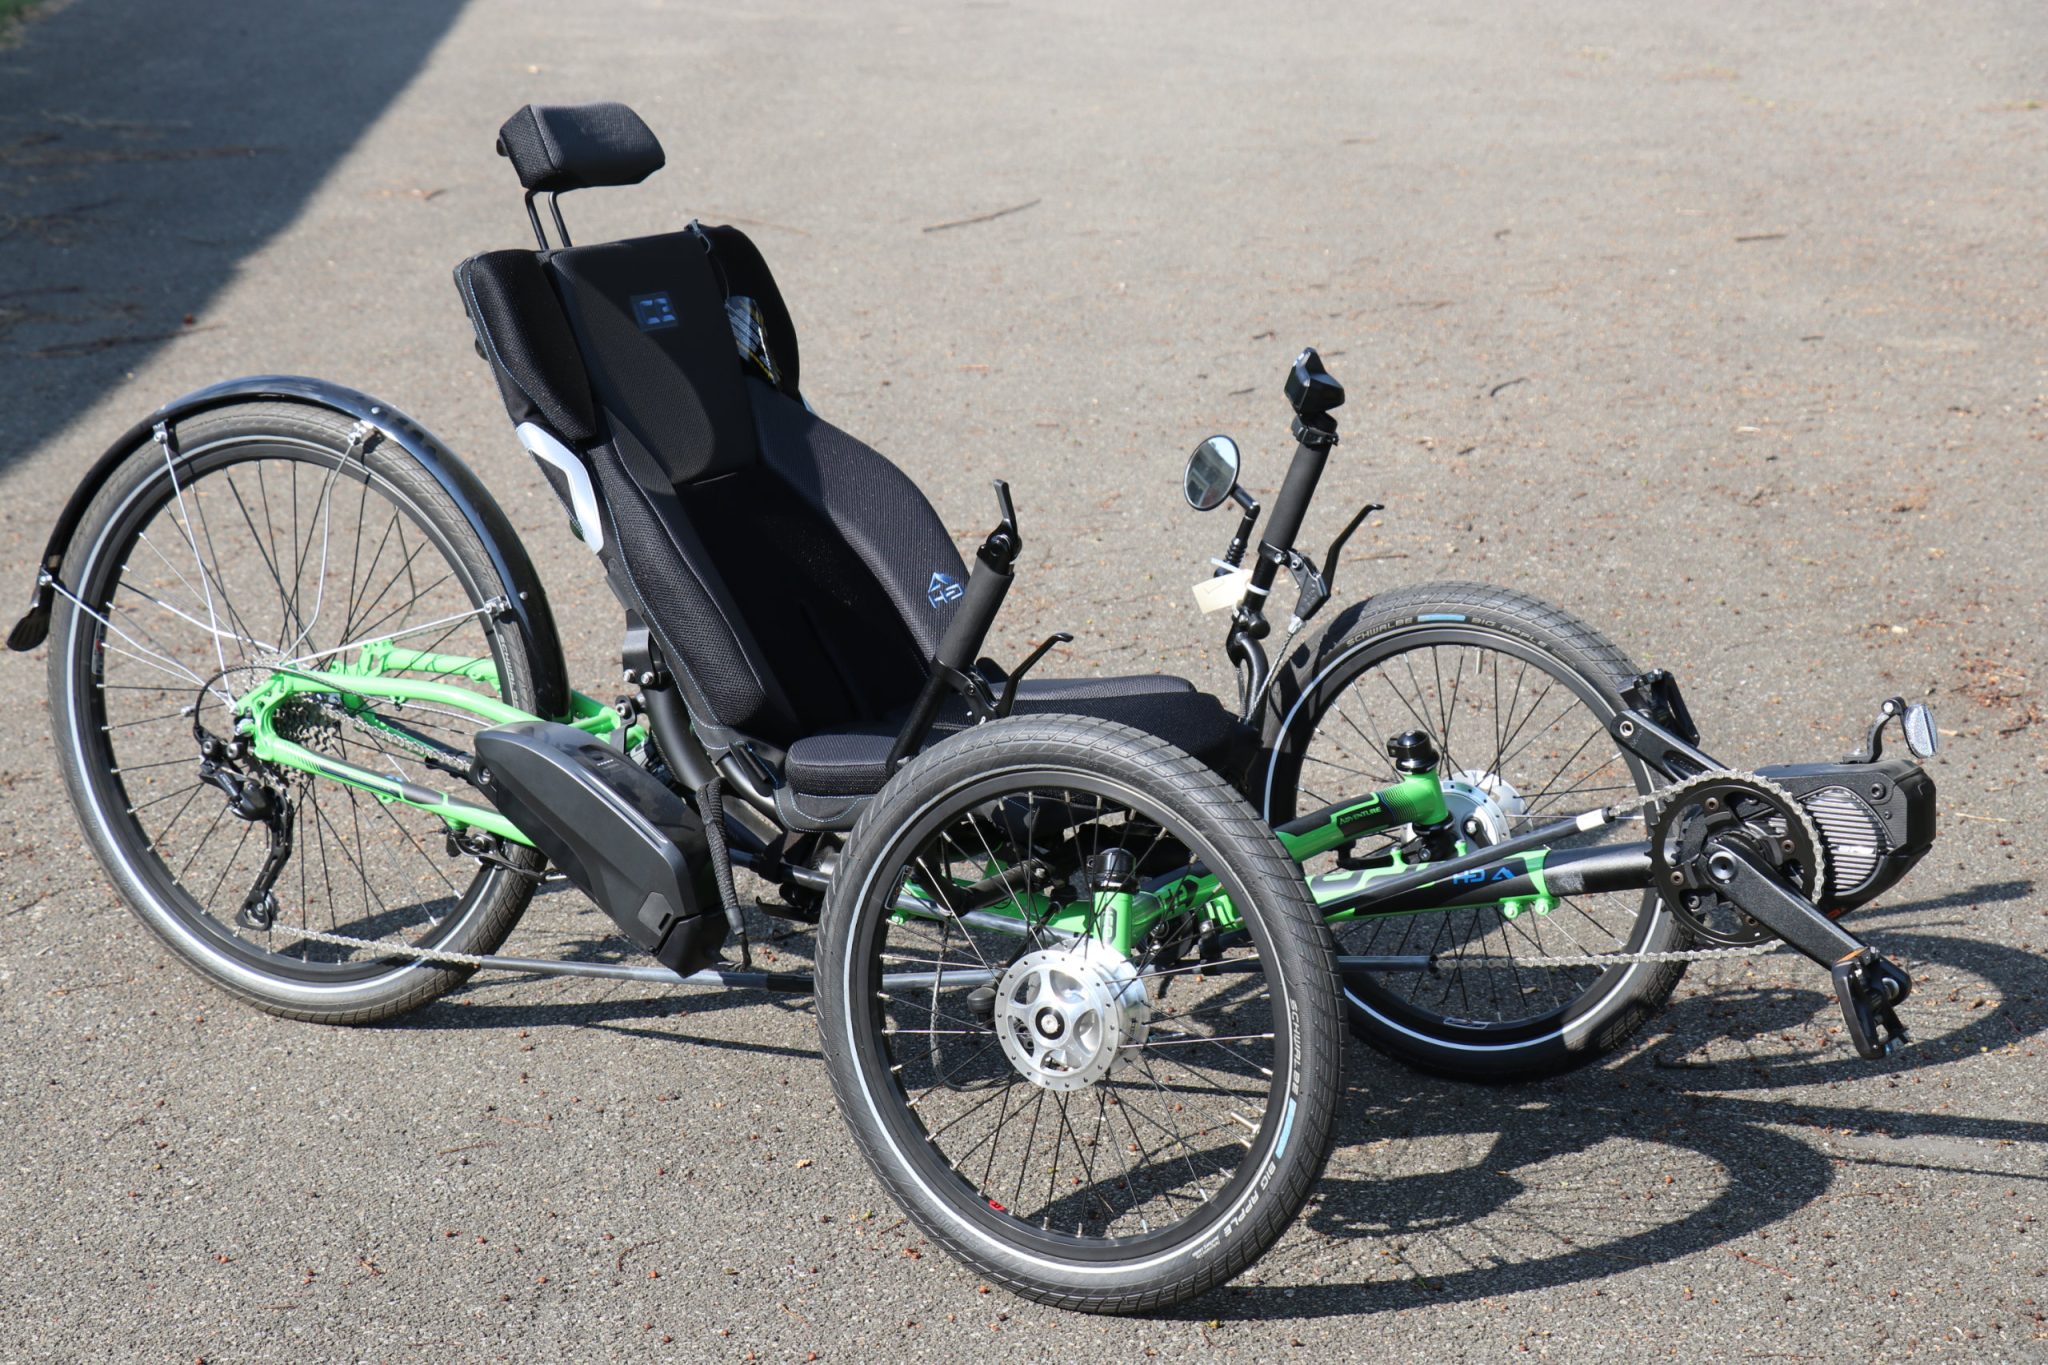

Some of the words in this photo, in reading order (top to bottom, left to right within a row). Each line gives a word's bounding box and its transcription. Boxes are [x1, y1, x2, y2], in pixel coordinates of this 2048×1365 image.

[1346, 617, 1414, 647] SCHWALBE
[1471, 617, 1497, 627] BIG
[1500, 624, 1548, 648] APPLE
[1340, 806, 1382, 825] ADVENTURE
[1289, 997, 1301, 1096] SCHWALBE
[1260, 1164, 1277, 1191] BIG
[1223, 1189, 1260, 1237] APPLE
